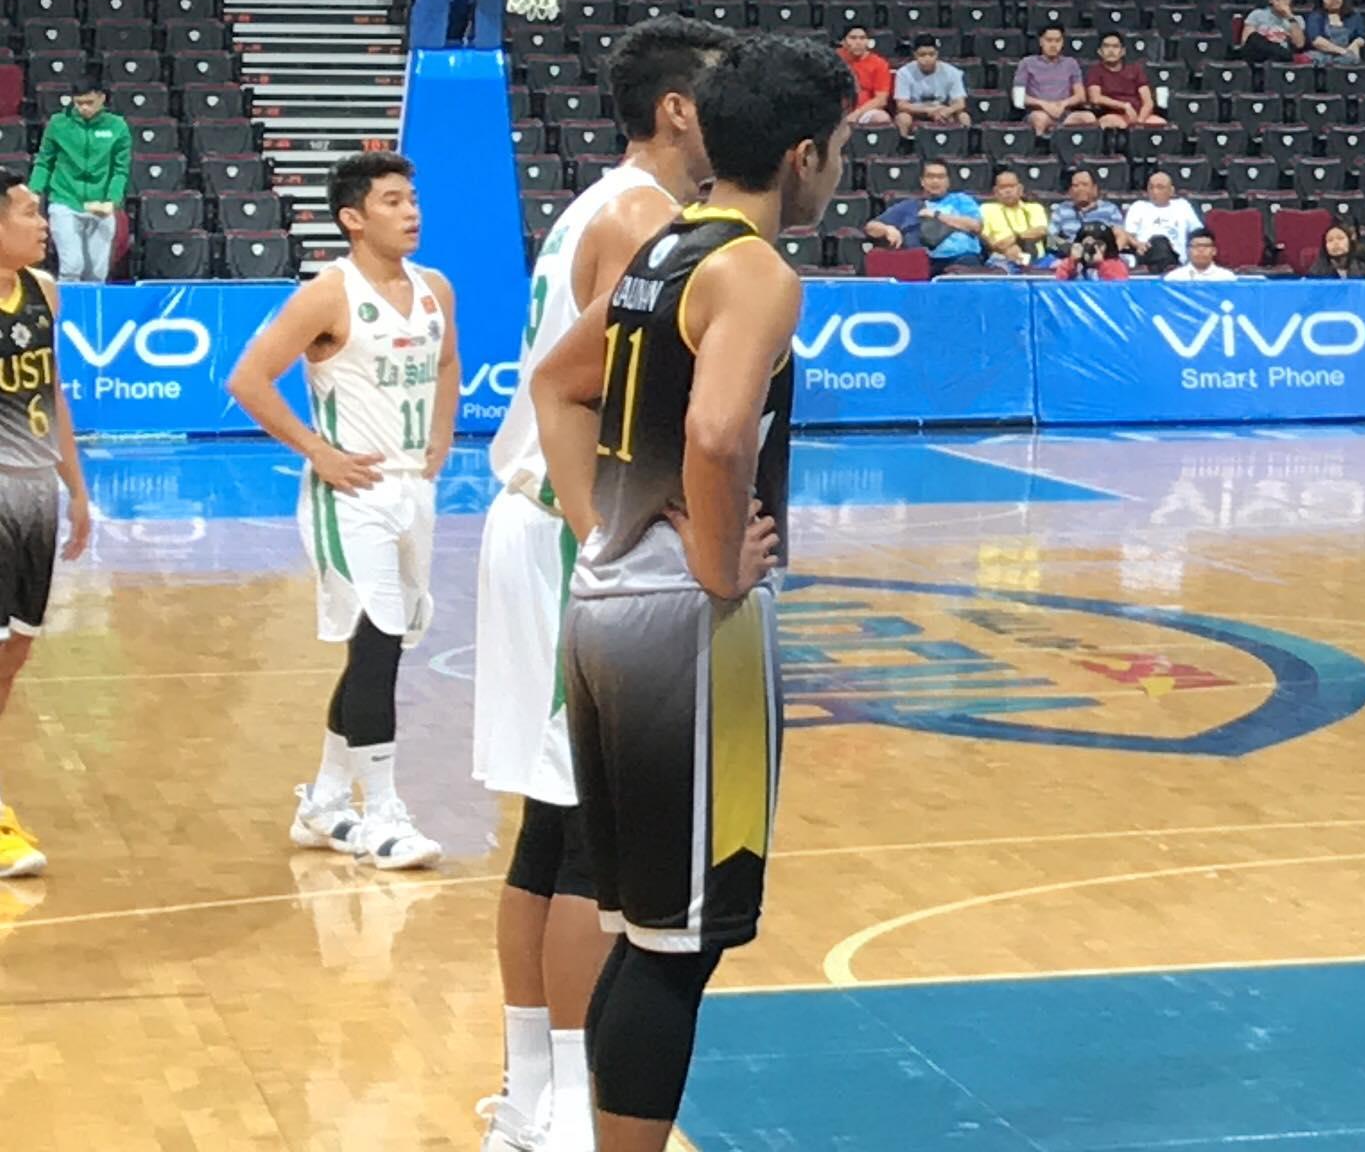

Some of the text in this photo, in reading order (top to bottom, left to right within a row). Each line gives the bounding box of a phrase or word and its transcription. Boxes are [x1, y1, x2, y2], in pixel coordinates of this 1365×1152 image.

[61, 318, 210, 367] vo
[792, 313, 911, 359] vo
[0, 346, 54, 393] UST
[402, 354, 437, 389] Sall
[459, 362, 521, 396] vo
[805, 368, 887, 390] Phone
[1181, 366, 1345, 389] Smart Phone
[94, 377, 182, 399] Phone
[27, 393, 50, 438] 6
[400, 398, 426, 450] 11
[463, 403, 507, 420] Phon
